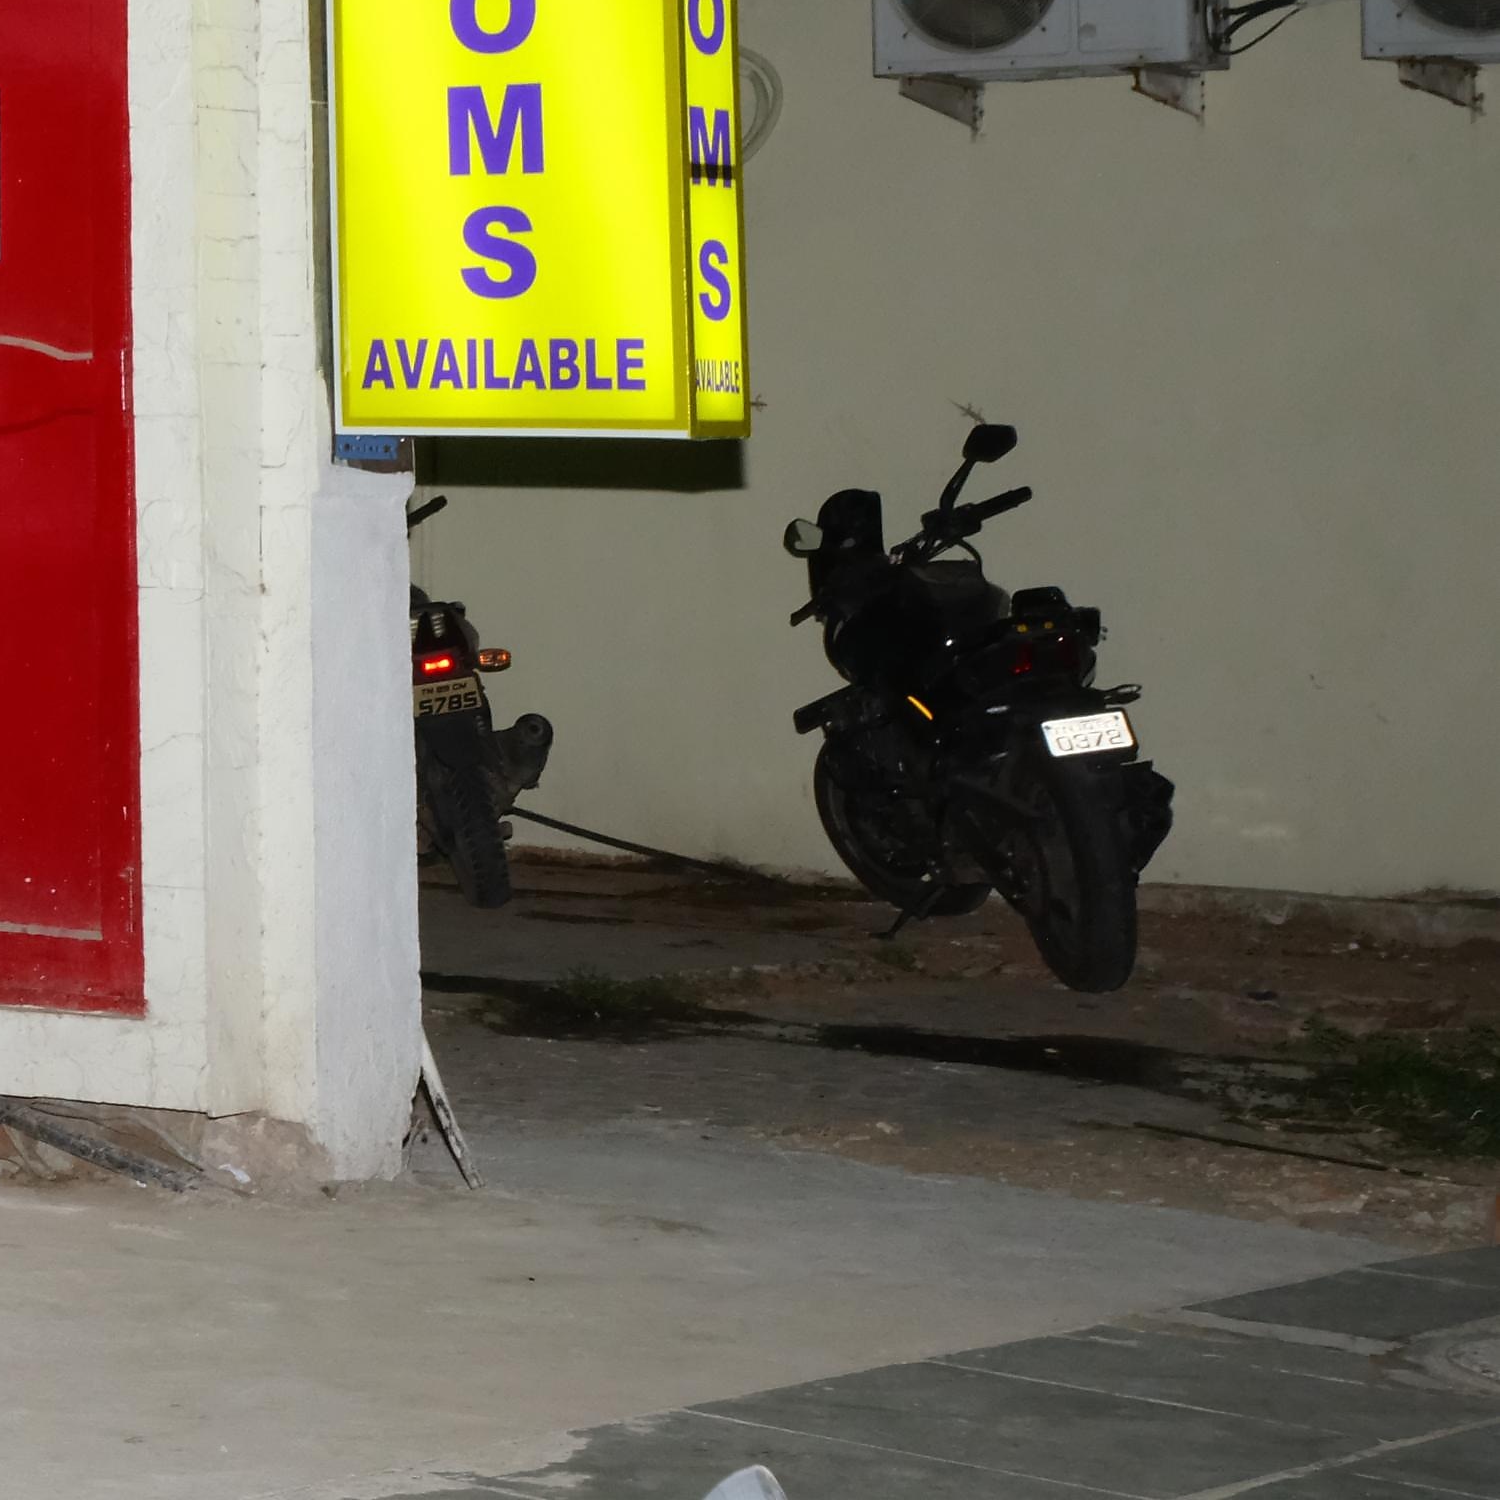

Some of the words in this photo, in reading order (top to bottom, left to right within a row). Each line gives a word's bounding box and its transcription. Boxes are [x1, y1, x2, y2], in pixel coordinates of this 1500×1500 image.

[361, 338, 646, 391] AVAILABLE
[695, 359, 740, 394] AVAILABLE
[418, 690, 478, 716] 5785
[1056, 729, 1125, 752] 0372
